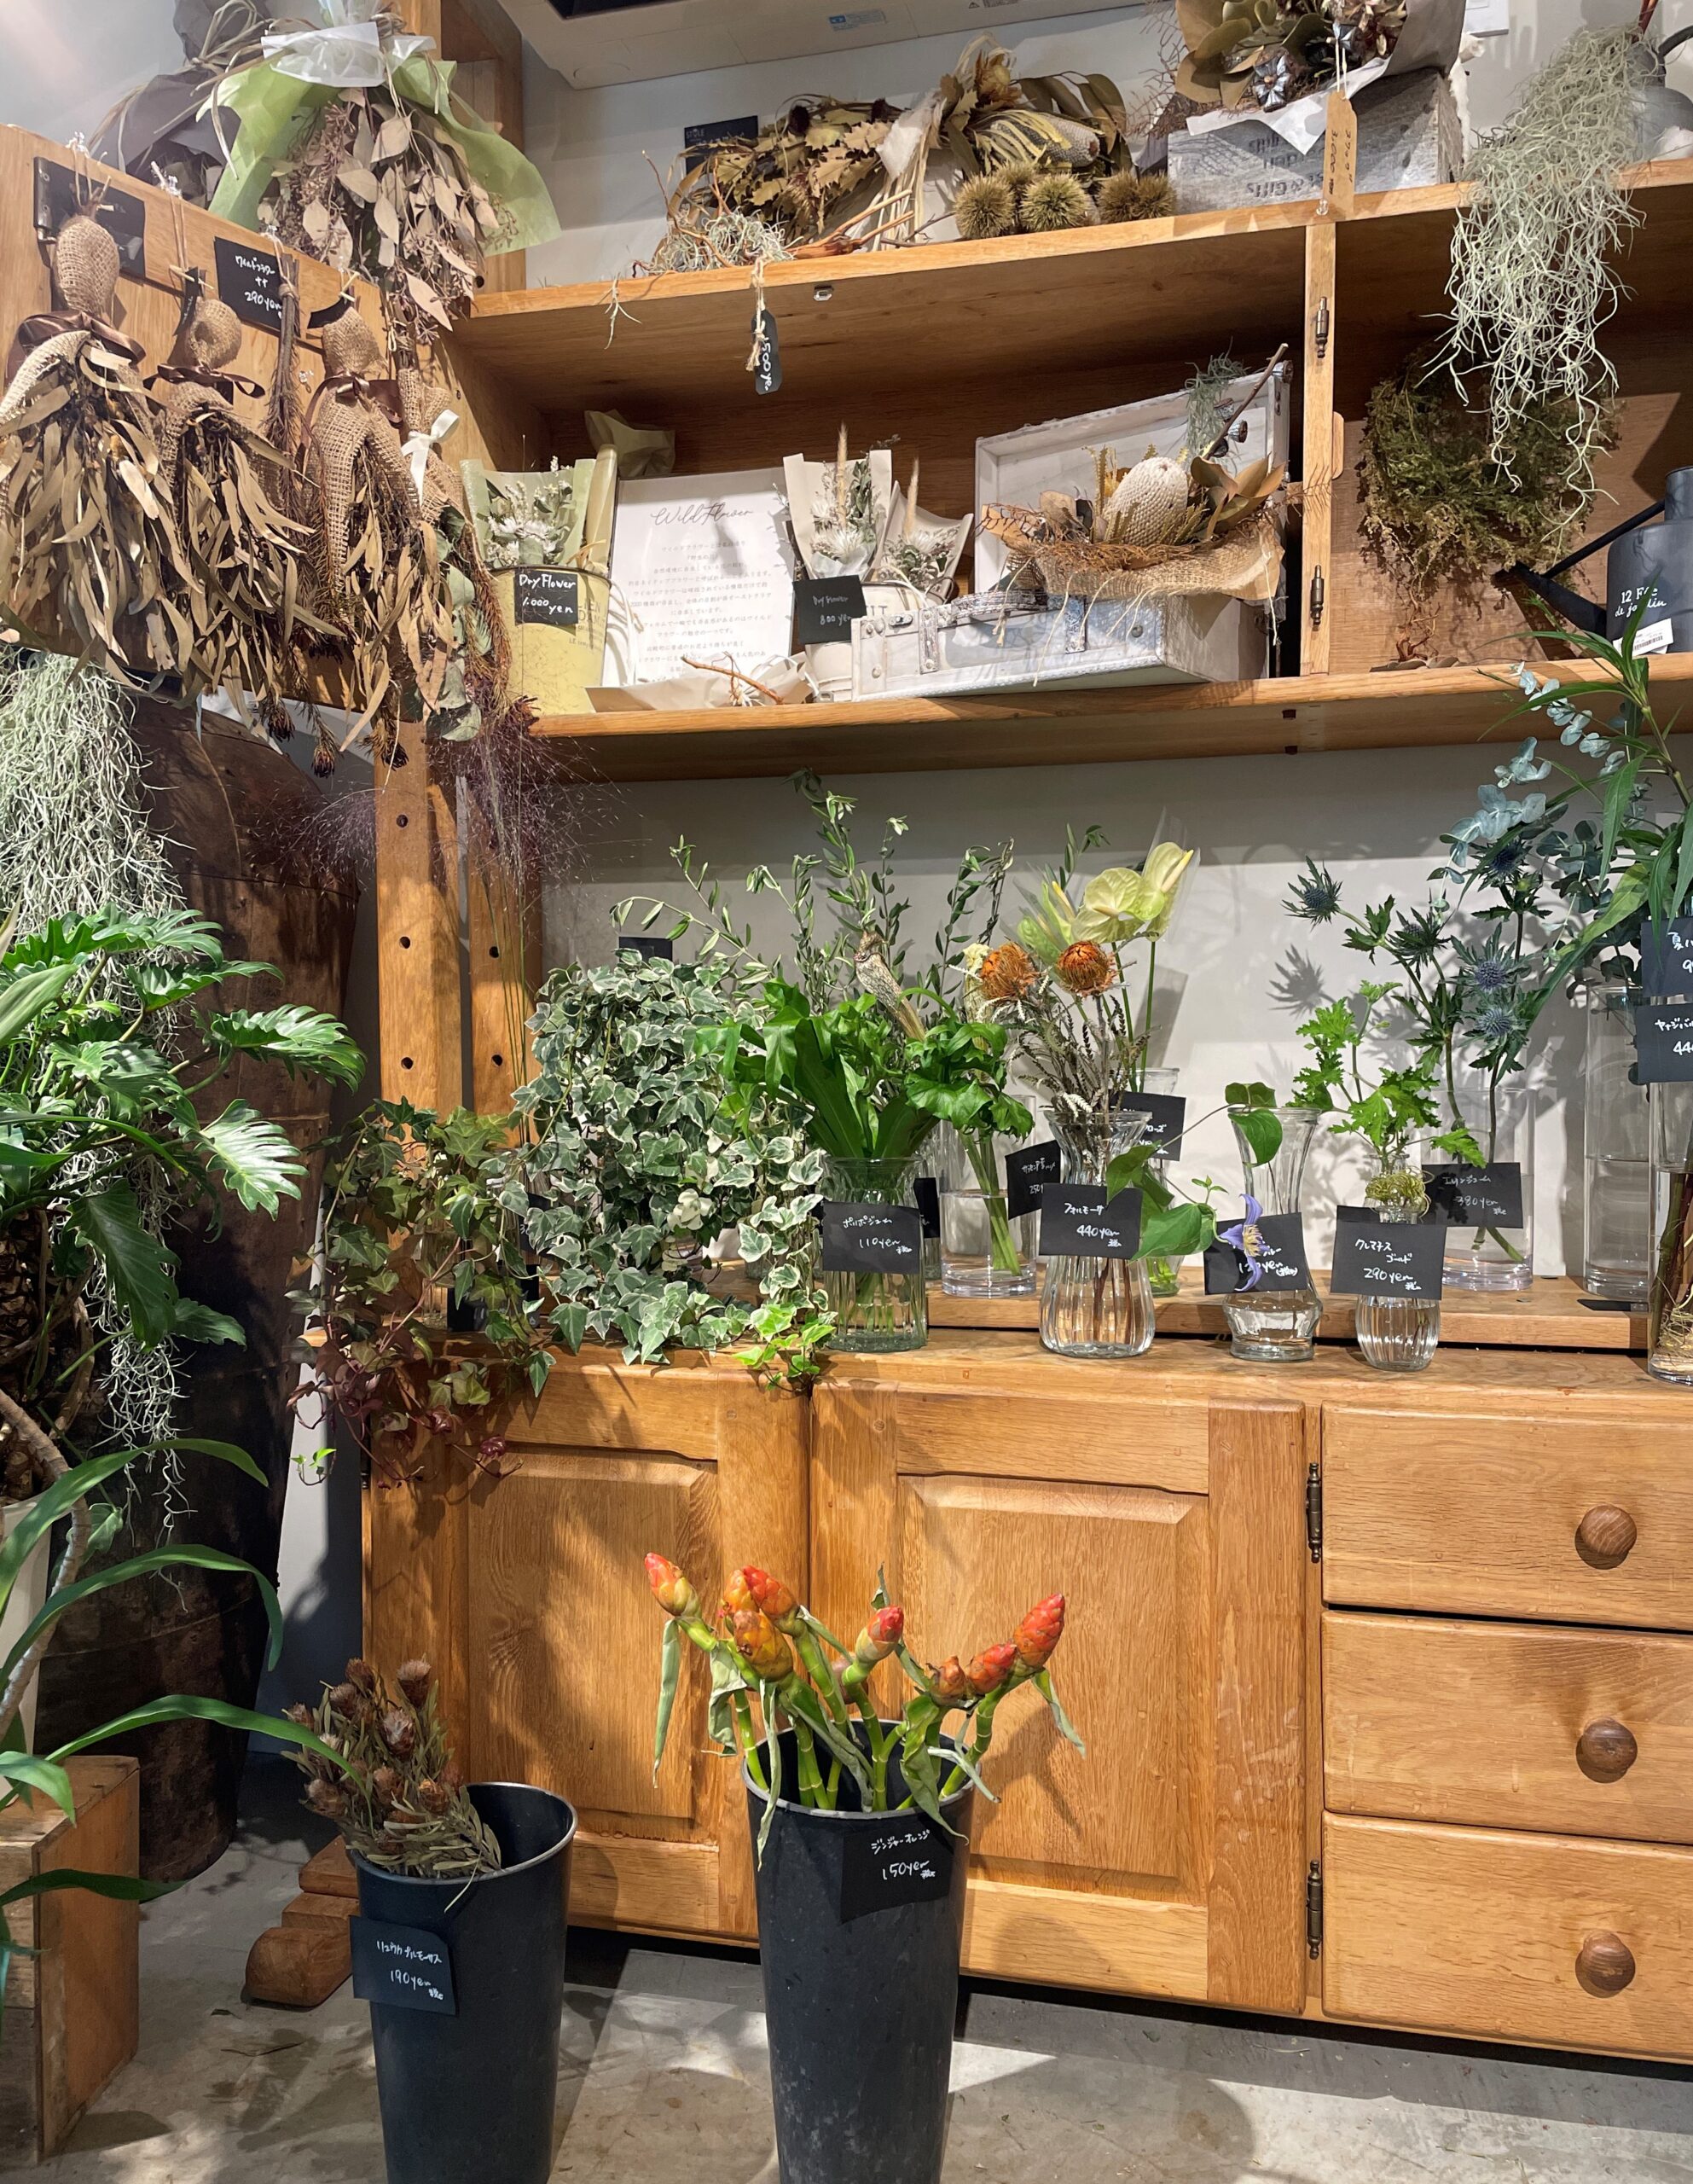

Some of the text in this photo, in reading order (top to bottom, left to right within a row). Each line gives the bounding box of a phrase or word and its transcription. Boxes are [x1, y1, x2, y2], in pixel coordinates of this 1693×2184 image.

[519, 573, 576, 589] Dry Flower
[1621, 590, 1632, 604] 12
[548, 605, 573, 615] yen
[1354, 1238, 1393, 1252] クレマチス
[1385, 1252, 1413, 1263] ゴールド
